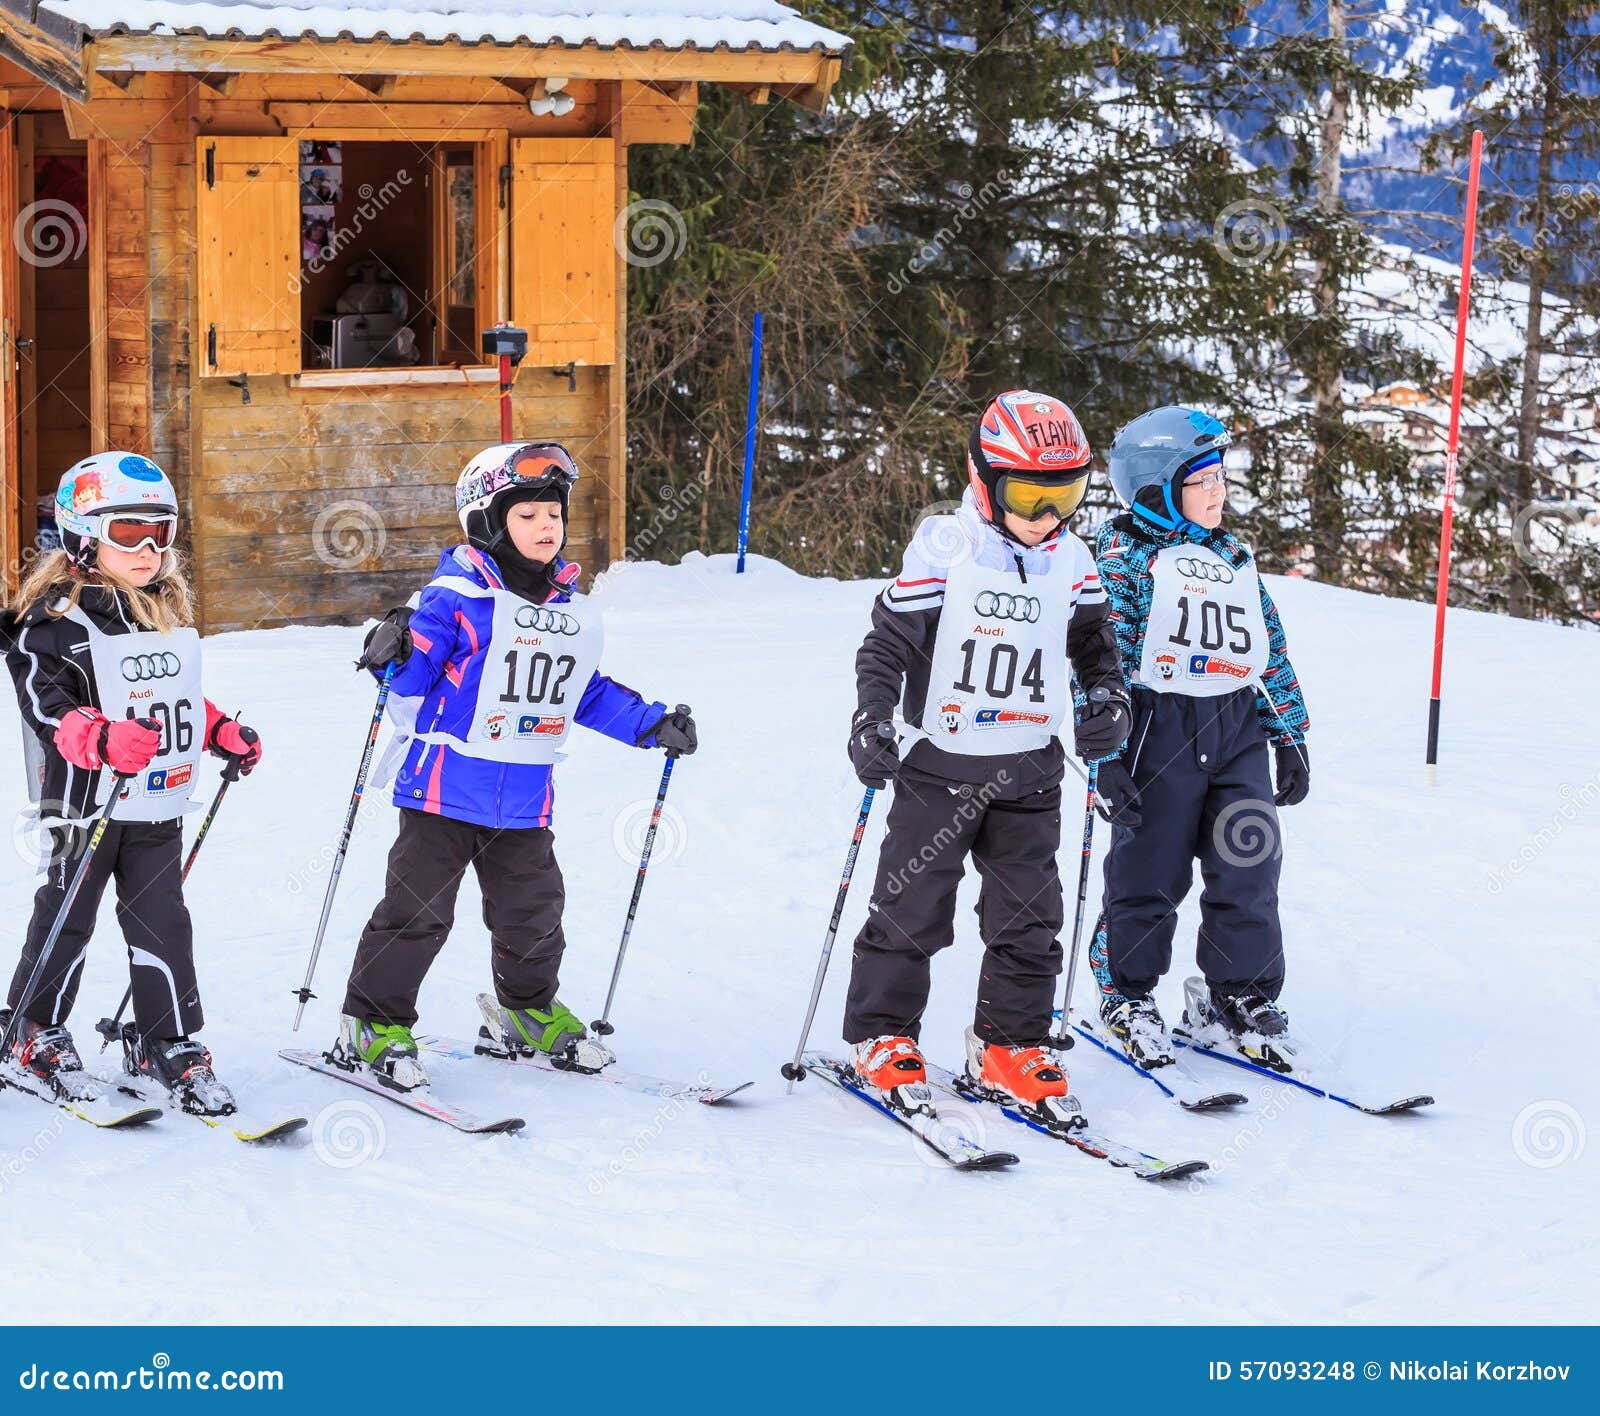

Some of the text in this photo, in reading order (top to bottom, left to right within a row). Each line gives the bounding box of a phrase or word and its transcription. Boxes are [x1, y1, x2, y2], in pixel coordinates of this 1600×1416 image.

[1184, 584, 1208, 595] Audi
[973, 625, 1006, 637] Audi
[1169, 597, 1252, 655] 105
[514, 636, 542, 646] Audi
[953, 639, 1045, 702] 104
[499, 650, 577, 705] 102
[128, 688, 154, 700] Audi
